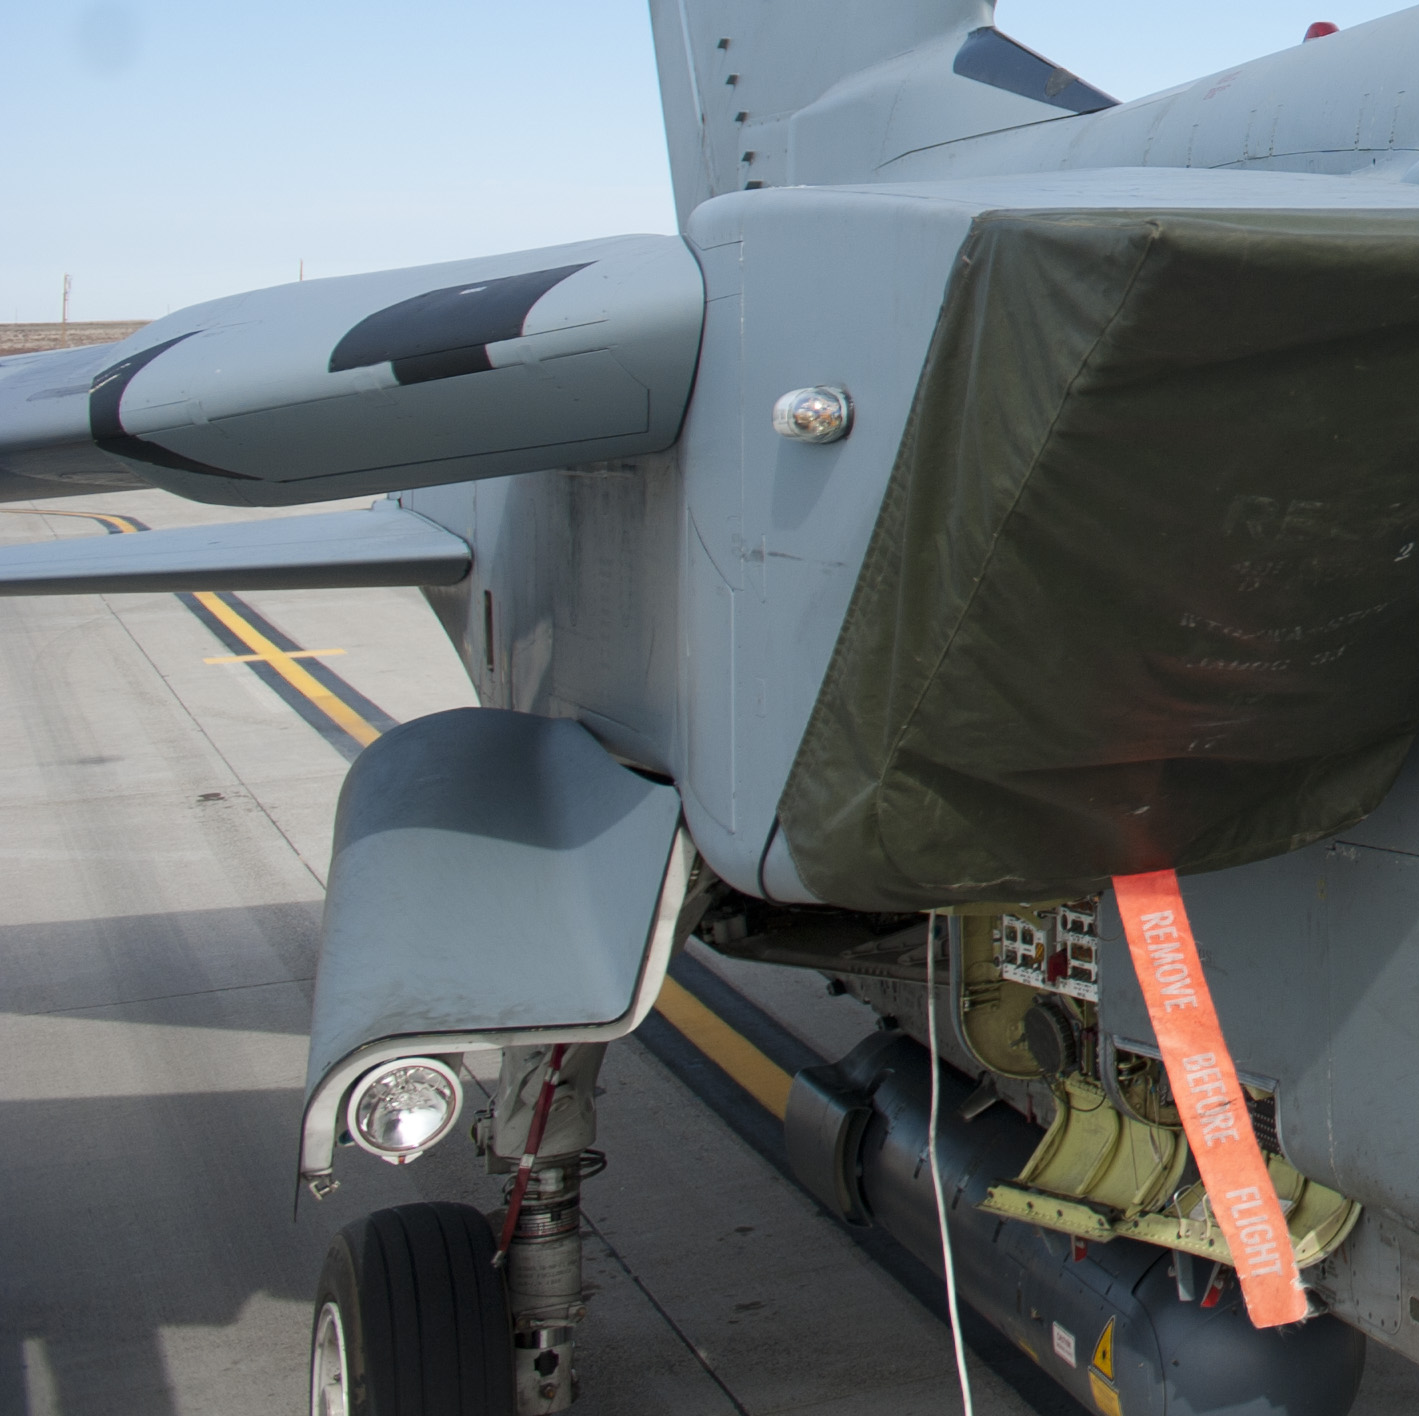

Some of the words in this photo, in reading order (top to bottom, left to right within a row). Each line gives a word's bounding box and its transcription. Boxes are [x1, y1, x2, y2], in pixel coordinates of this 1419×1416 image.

[1140, 910, 1198, 1013] REMOVE
[1182, 1051, 1239, 1148] BEFORE
[1225, 1186, 1284, 1278] FLIGHT
